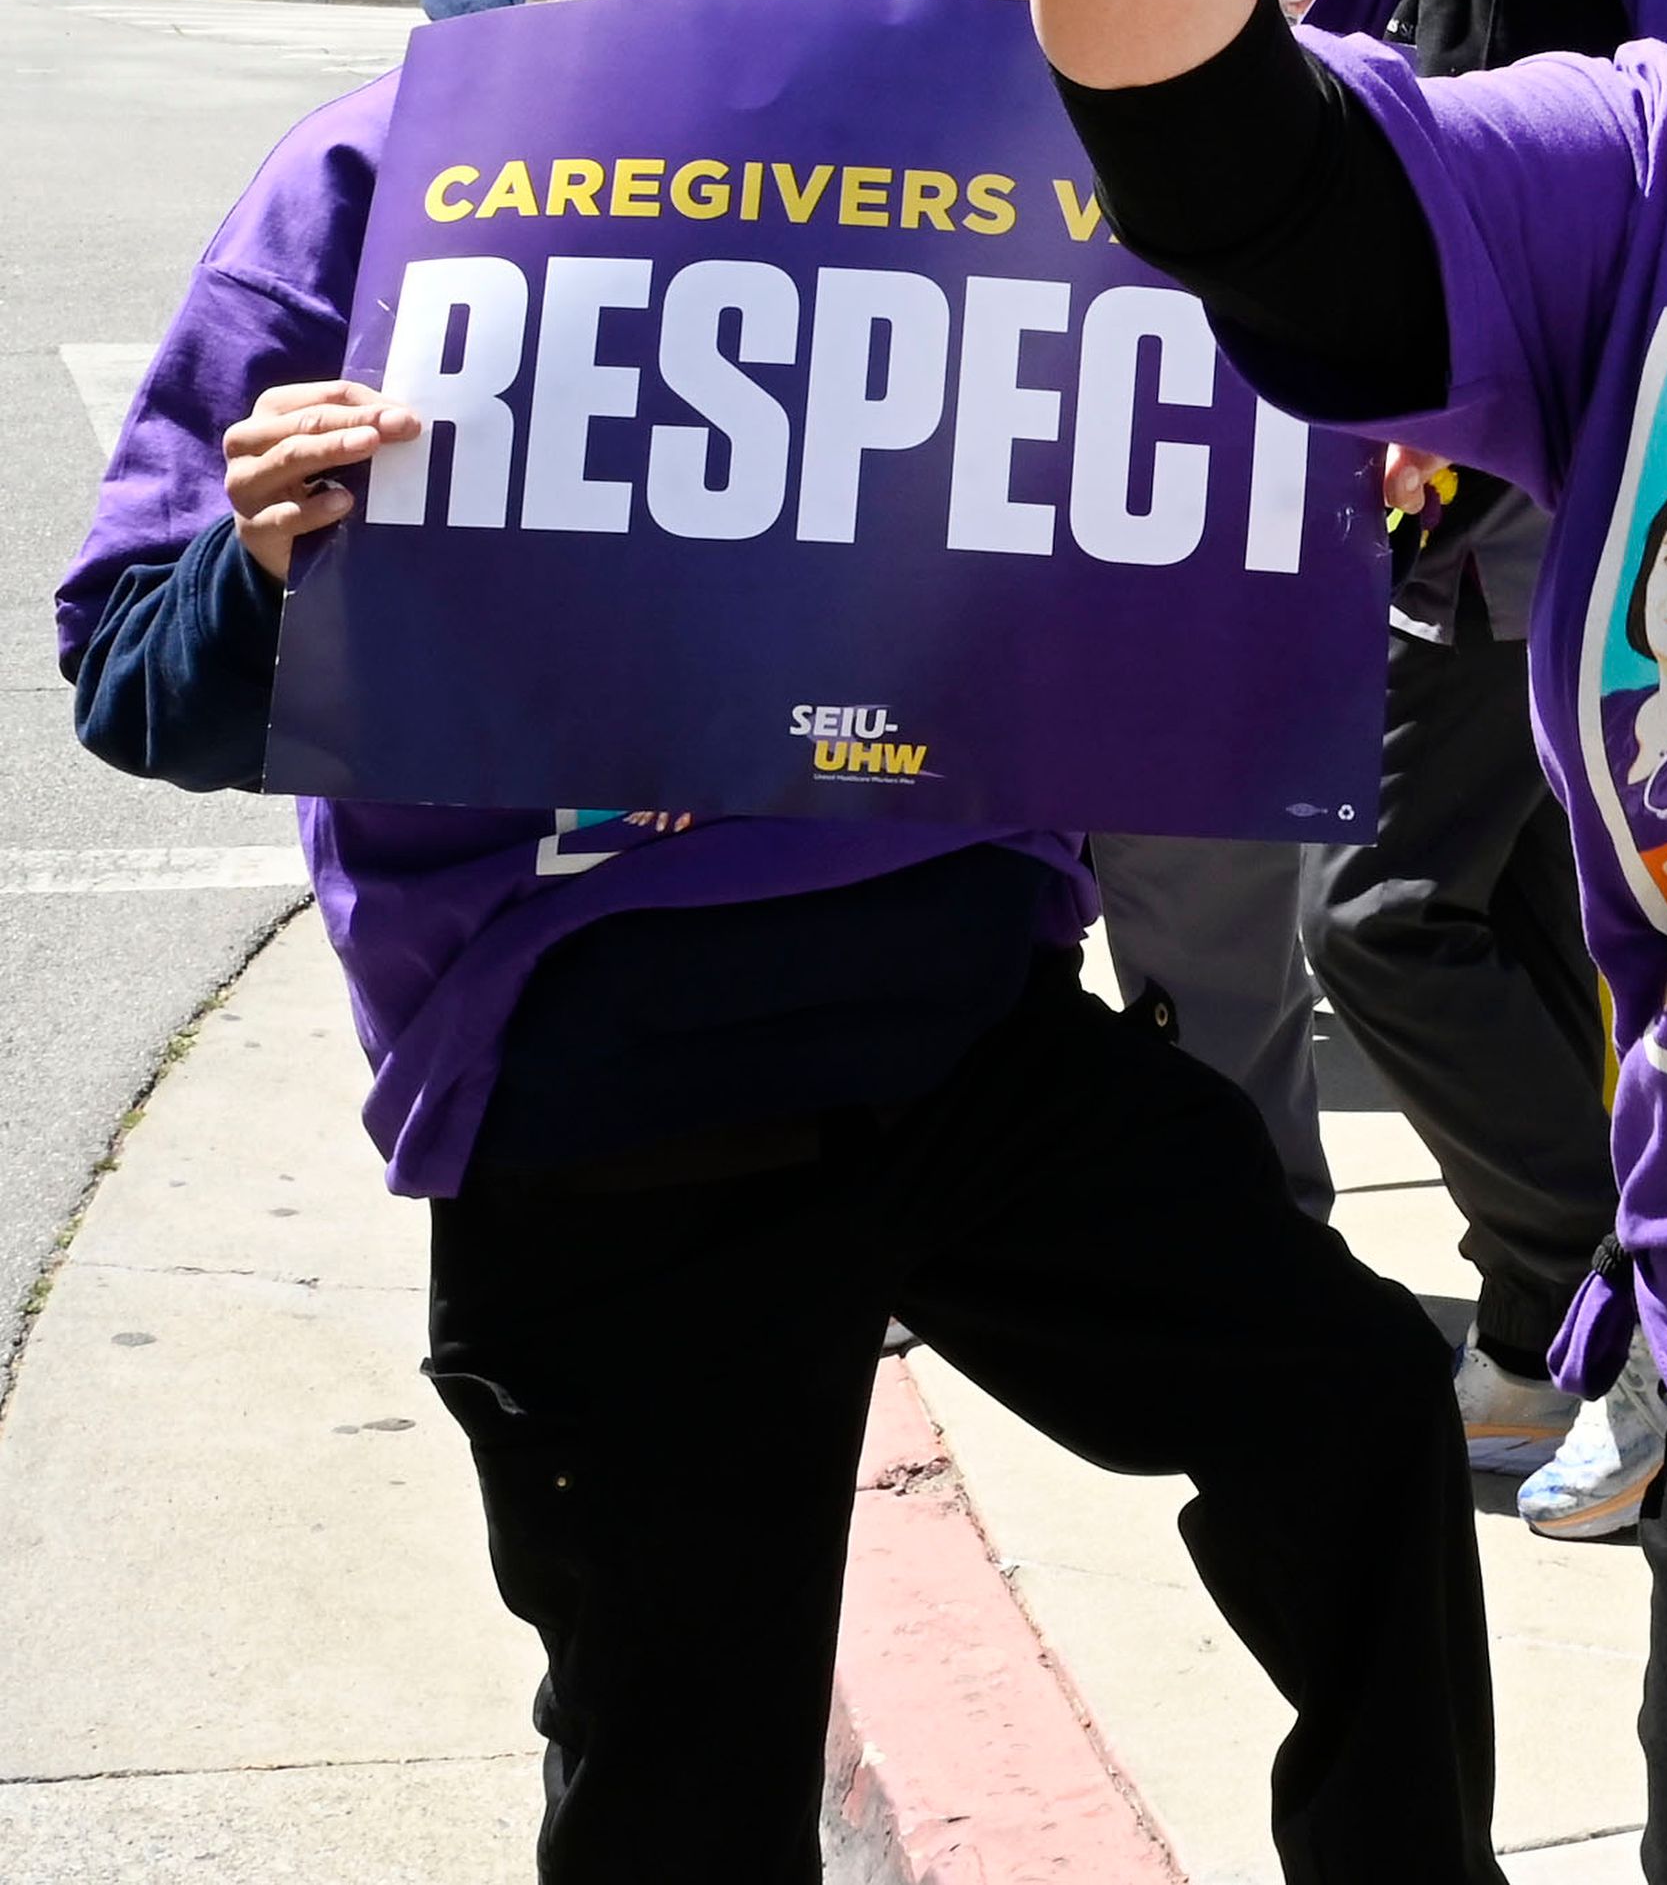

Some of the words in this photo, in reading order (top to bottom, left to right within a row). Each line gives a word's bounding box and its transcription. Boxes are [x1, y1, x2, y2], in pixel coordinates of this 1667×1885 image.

[426, 158, 1016, 235] CAREGIVERS
[789, 704, 899, 739] SEIU-
[814, 739, 927, 775] UHW
